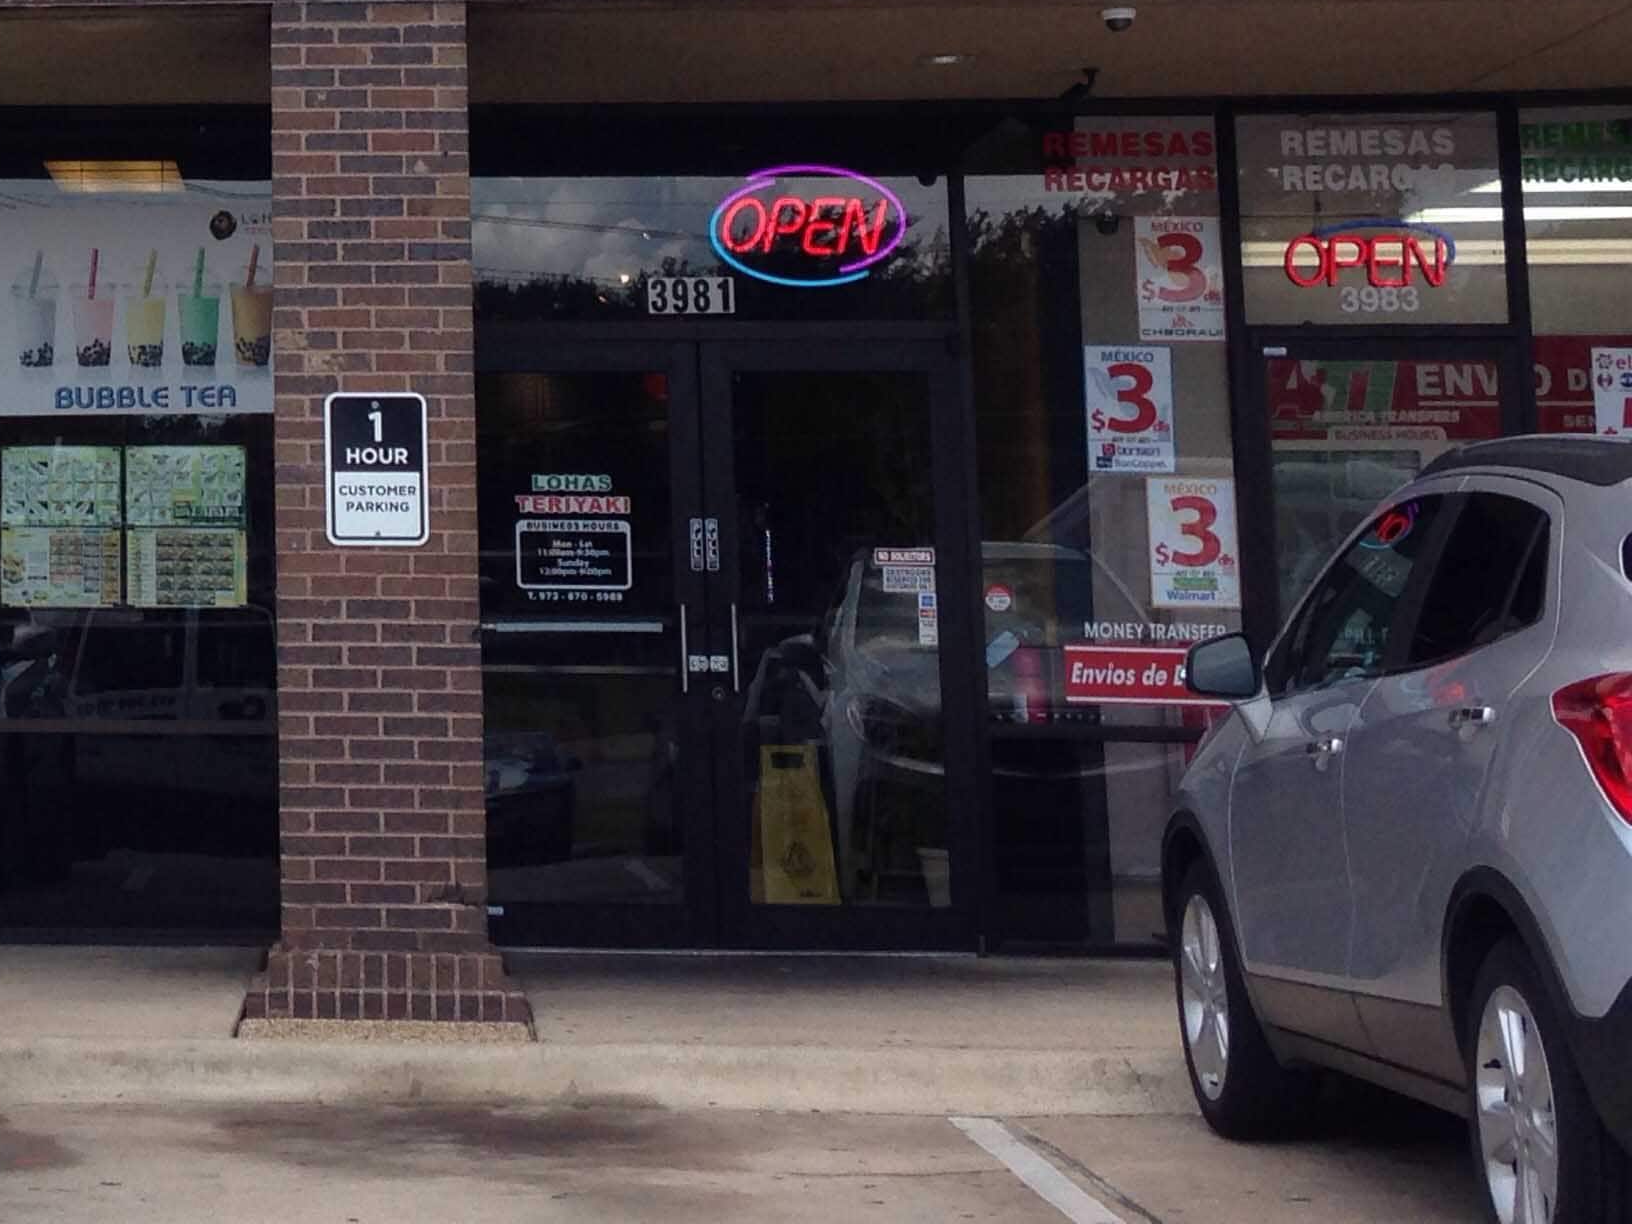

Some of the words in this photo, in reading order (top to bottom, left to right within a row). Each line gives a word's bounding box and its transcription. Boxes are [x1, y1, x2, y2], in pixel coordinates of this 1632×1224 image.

[1043, 131, 1213, 157] REMESAS
[1280, 129, 1456, 156] REMESAS
[1043, 163, 1216, 192] RECARGAS
[722, 196, 888, 256] OPEN
[1283, 235, 1448, 289] OPEN
[649, 280, 733, 312] 3981
[1341, 286, 1421, 313] 3983
[53, 386, 169, 410] BUBBLE
[180, 385, 237, 408] TEA
[367, 410, 383, 443] 1
[345, 447, 409, 466] HOUR
[338, 484, 418, 497] CUSTOMER
[531, 474, 612, 491] LOHAS
[345, 501, 411, 513] PARKING
[515, 495, 632, 514] TERIYAKI
[1166, 590, 1217, 602] Walmart
[1084, 622, 1143, 639] MONEY
[1142, 664, 1168, 686] de
